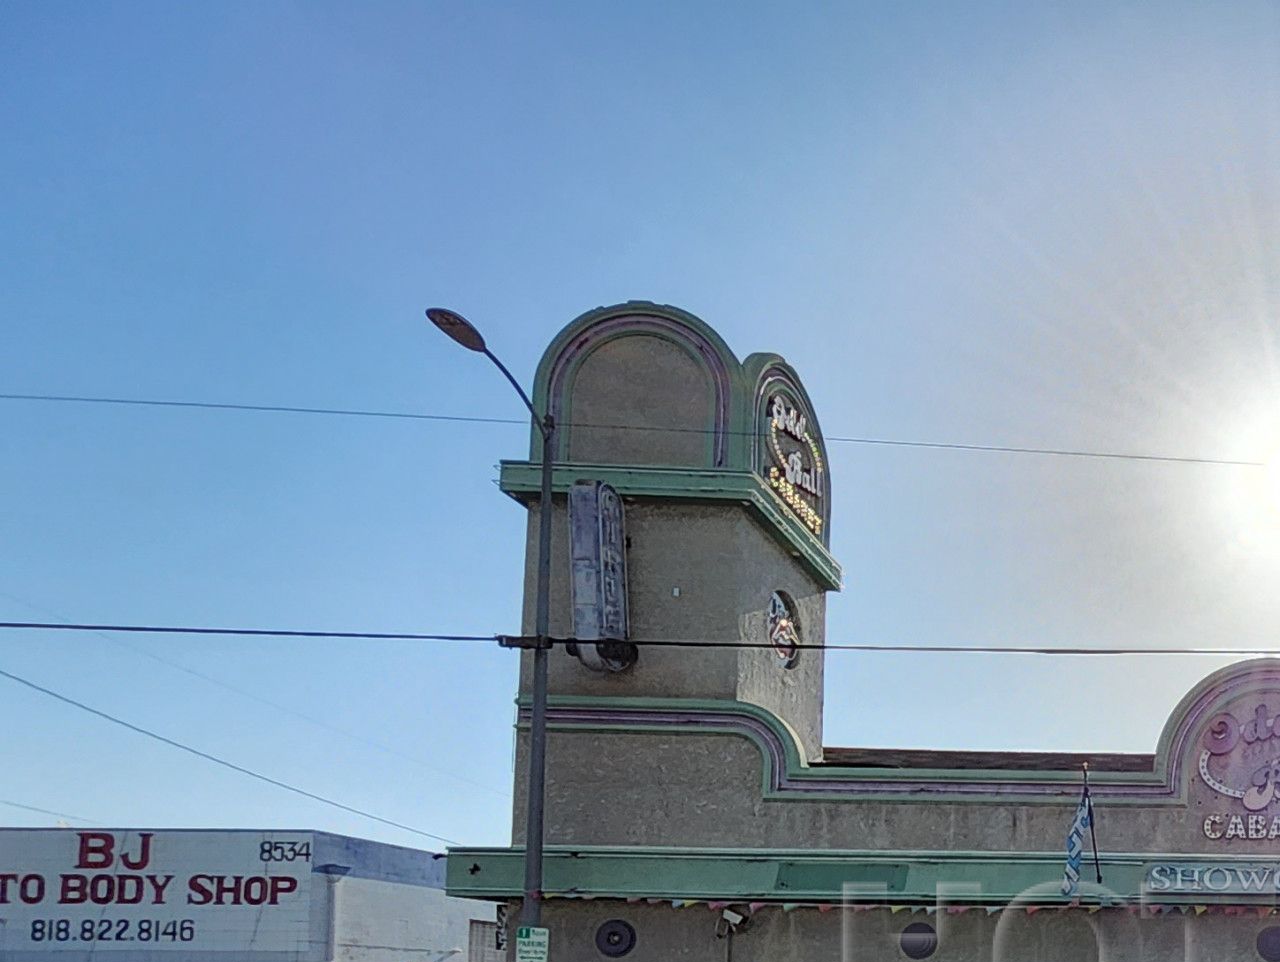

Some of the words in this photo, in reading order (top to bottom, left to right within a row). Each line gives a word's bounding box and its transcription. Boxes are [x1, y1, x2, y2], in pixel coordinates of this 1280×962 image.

[74, 832, 154, 870] BJ
[259, 841, 312, 862] 8534
[58, 873, 175, 905] BODY
[187, 874, 298, 906] SHOP
[30, 919, 195, 942] 818.822.8146
